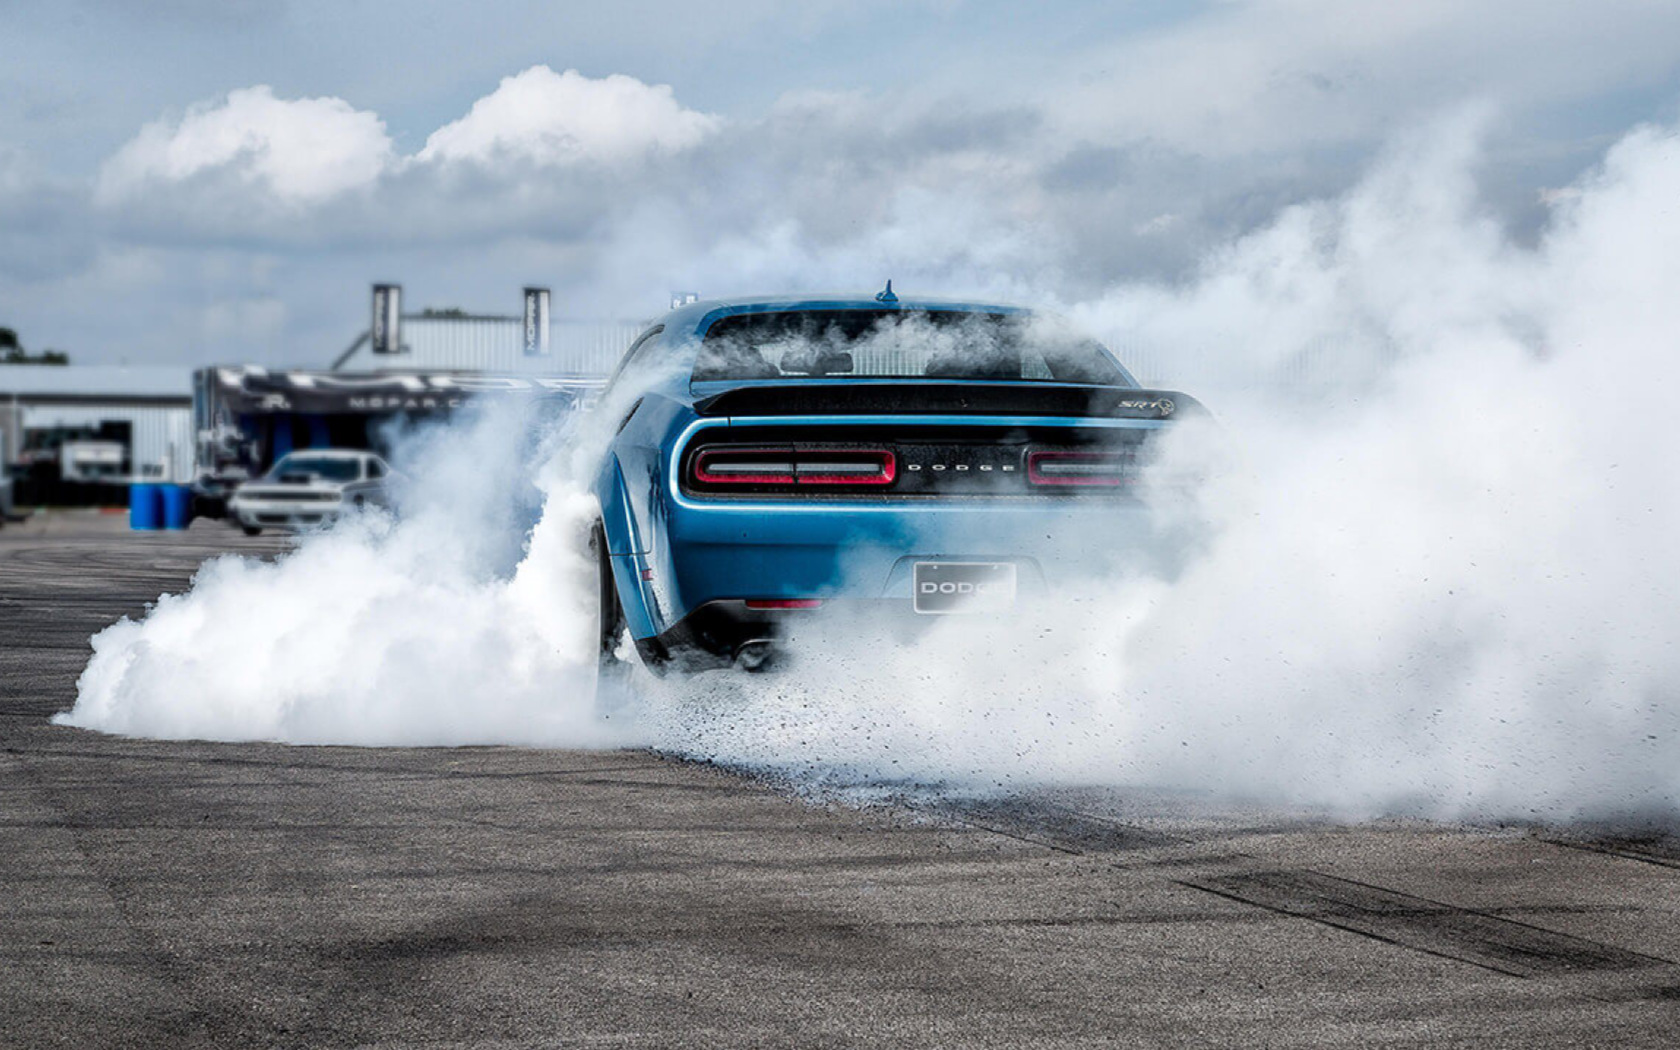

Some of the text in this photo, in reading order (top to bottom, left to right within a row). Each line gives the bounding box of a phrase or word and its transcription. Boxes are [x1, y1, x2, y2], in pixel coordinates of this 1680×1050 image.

[1118, 400, 1159, 410] SRT
[908, 463, 1015, 471] DODGE
[920, 581, 1009, 594] DOD
